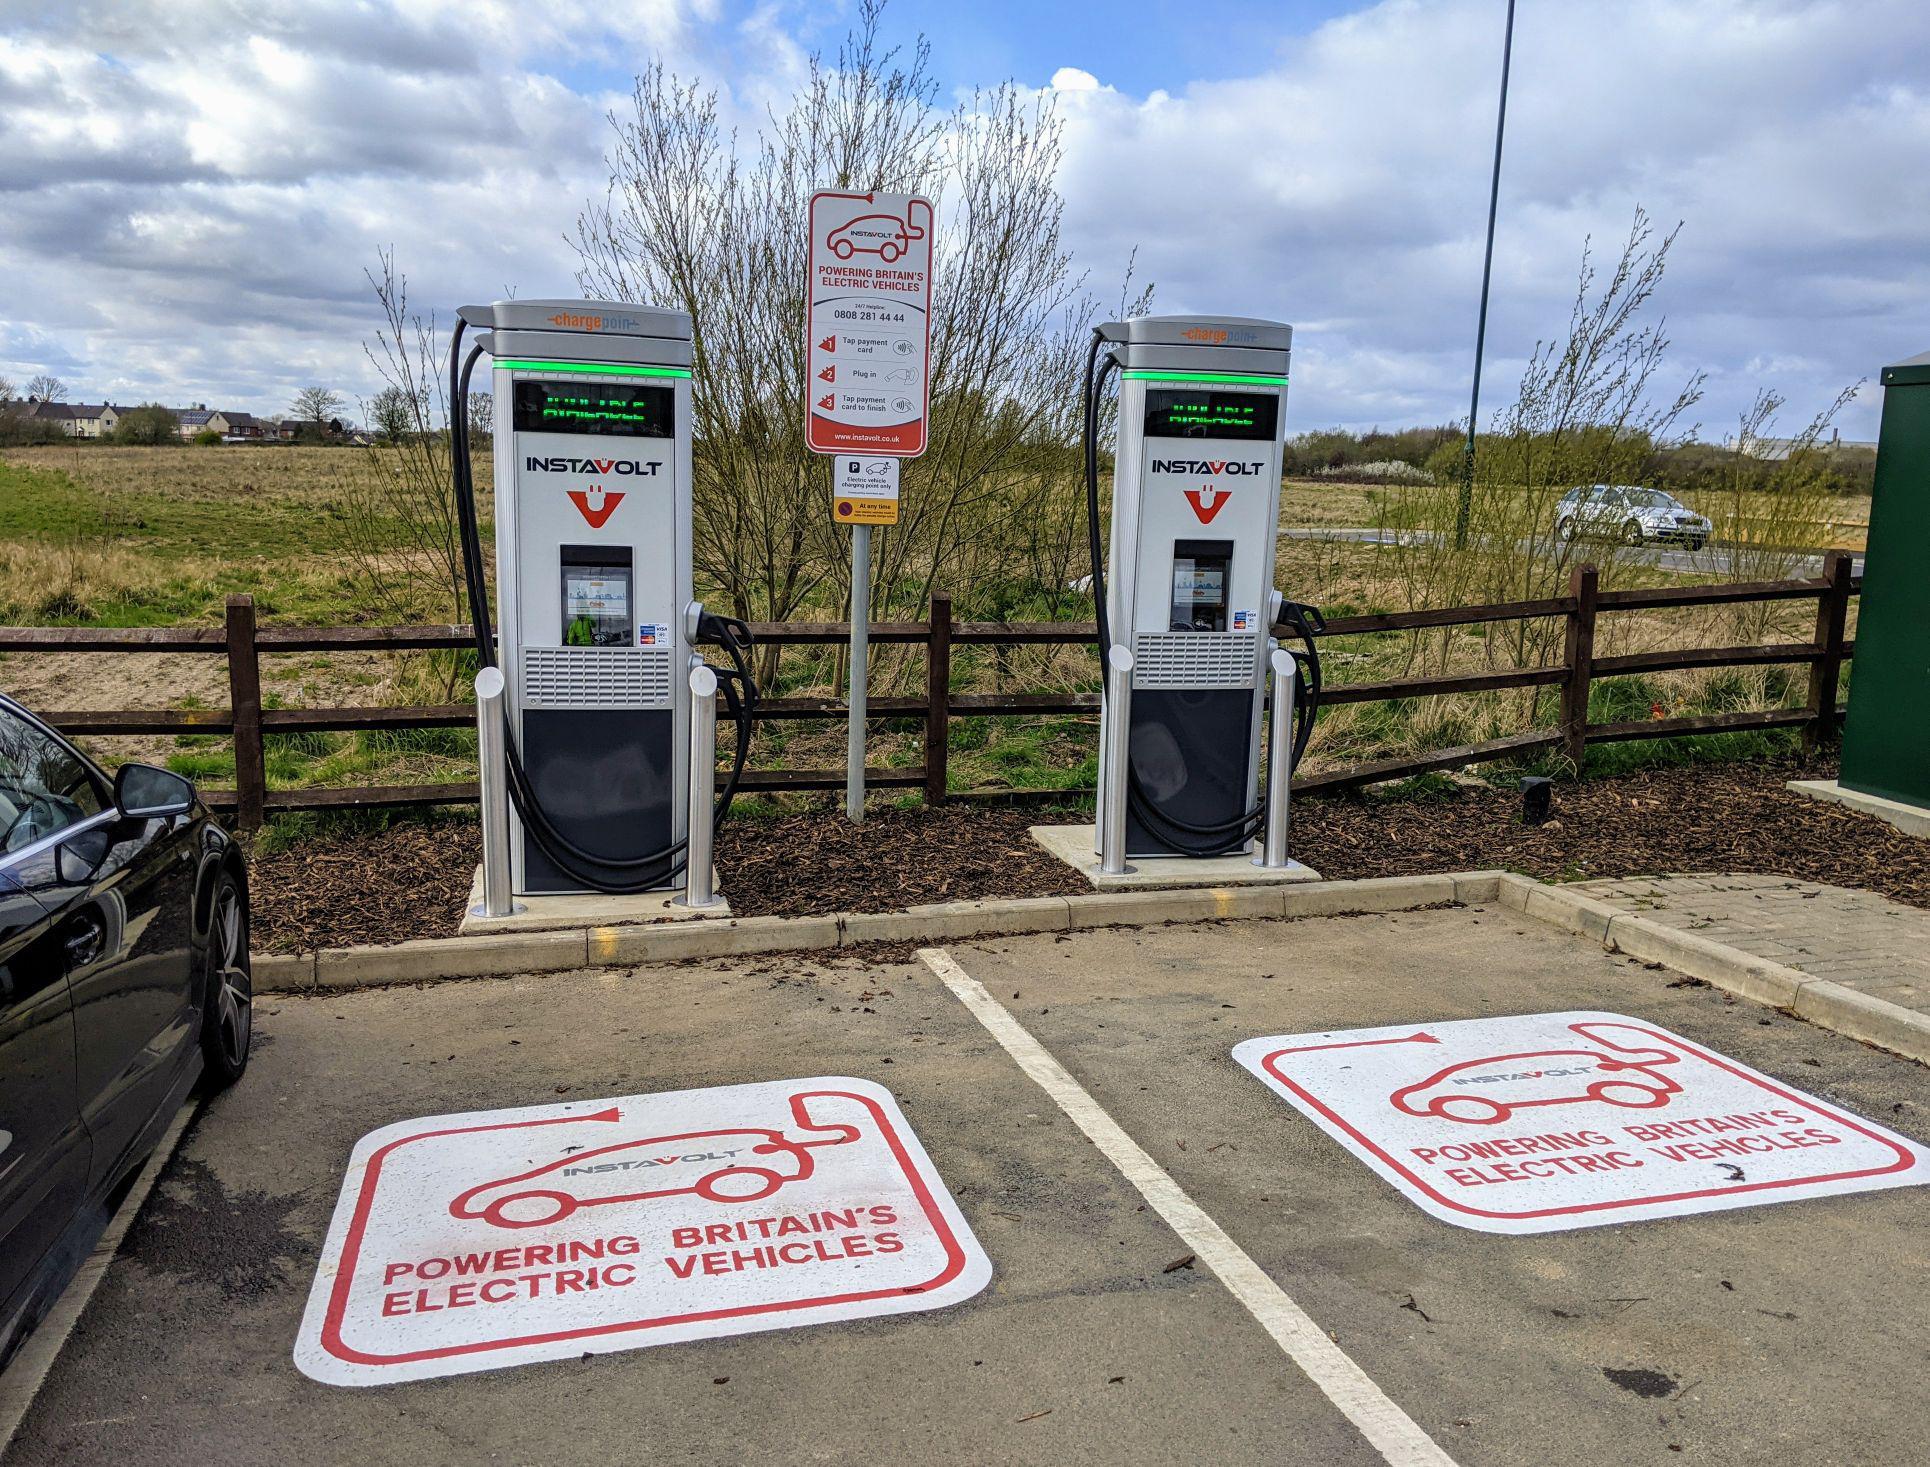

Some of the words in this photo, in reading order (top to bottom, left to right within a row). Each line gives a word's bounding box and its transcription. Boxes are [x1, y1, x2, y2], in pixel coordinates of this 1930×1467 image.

[850, 230, 893, 239] INSTAVOLT
[818, 265, 873, 278] POWERING
[875, 269, 924, 281] BRITAIN'S
[822, 277, 870, 289] ELECTRIC
[872, 280, 920, 292] VEHICLES
[834, 309, 857, 320] 0808
[860, 311, 876, 321] 281
[879, 313, 891, 321] 44
[893, 313, 905, 322] 44
[843, 337, 856, 345] Tap
[857, 338, 888, 346] payment
[857, 346, 873, 354] card
[827, 370, 833, 379] 2
[853, 370, 868, 378] Plug
[826, 399, 832, 407] 3
[843, 395, 856, 403] Tap
[834, 433, 900, 443] www.instavolt.co.uk
[526, 457, 663, 476] INSTAVOLT
[1152, 459, 1265, 476] INSTAVOLT
[1453, 1066, 1594, 1086] INSTAVOLT
[1410, 1130, 1616, 1166] POWERING
[1622, 1110, 1807, 1143] BRITAIN'S
[562, 1148, 743, 1177] INSTAVOLT
[1443, 1150, 1645, 1188] ELECTRIC
[1651, 1128, 1843, 1164] VEHICLES
[383, 1235, 641, 1286] POWERING
[672, 1205, 899, 1250] BRITAIN'S
[381, 1263, 638, 1317] ELECTRIC
[665, 1232, 905, 1279] VEHICLES
